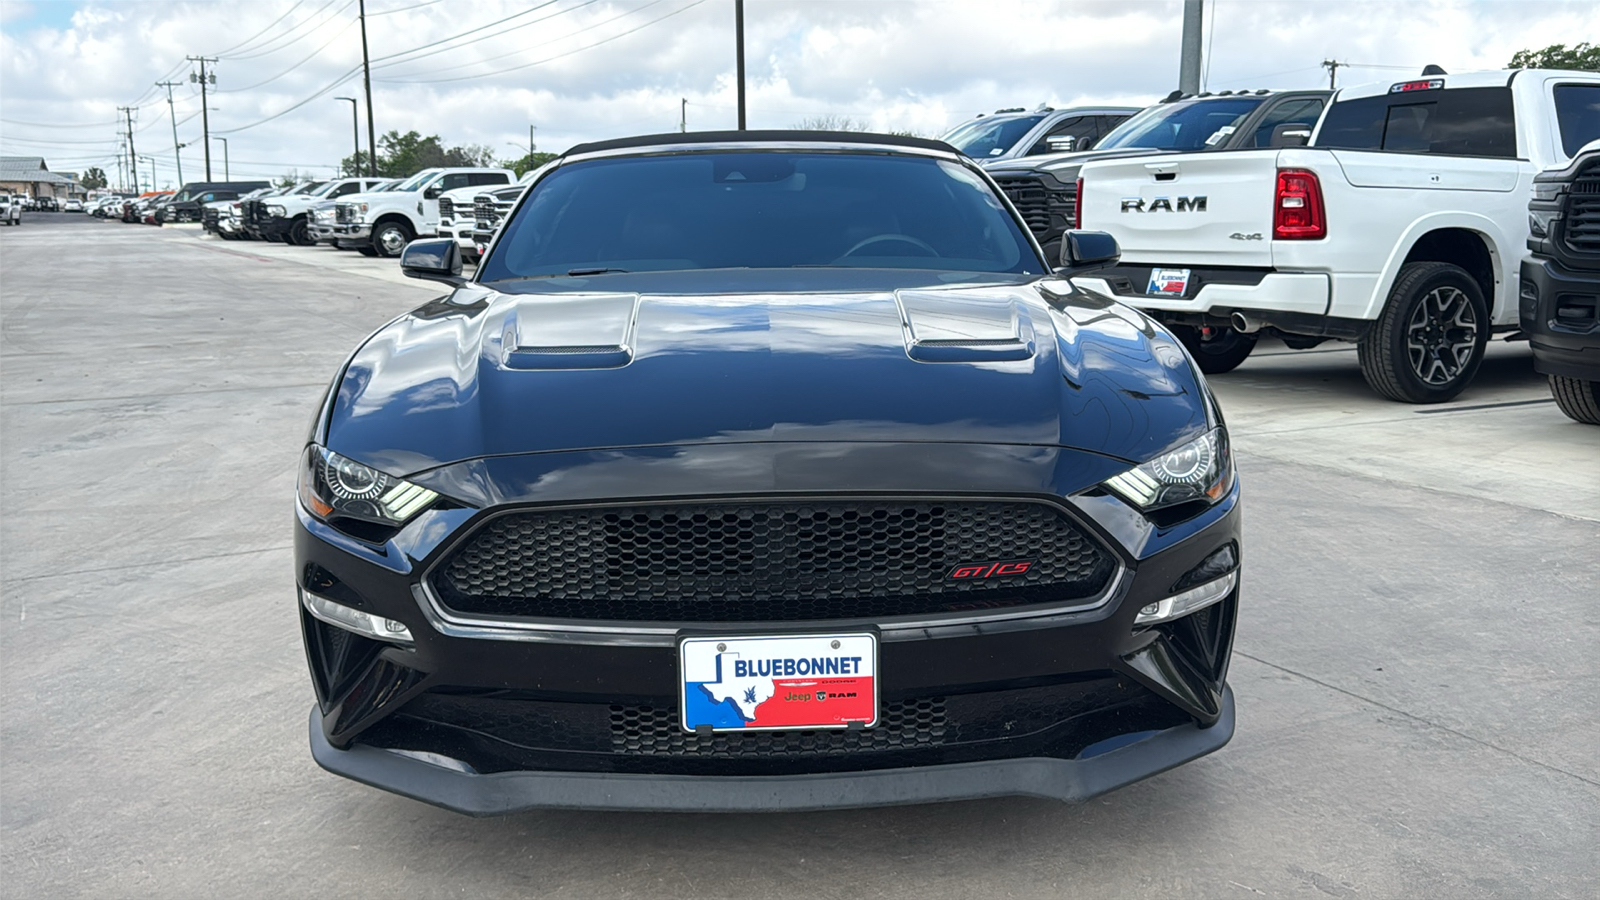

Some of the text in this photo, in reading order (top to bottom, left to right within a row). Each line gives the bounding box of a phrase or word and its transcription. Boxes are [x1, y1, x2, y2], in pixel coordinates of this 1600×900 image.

[1121, 196, 1208, 213] RAM
[953, 562, 1031, 578] GT/CS
[735, 657, 862, 677] BLUEBONNET
[784, 692, 812, 702] Jeep
